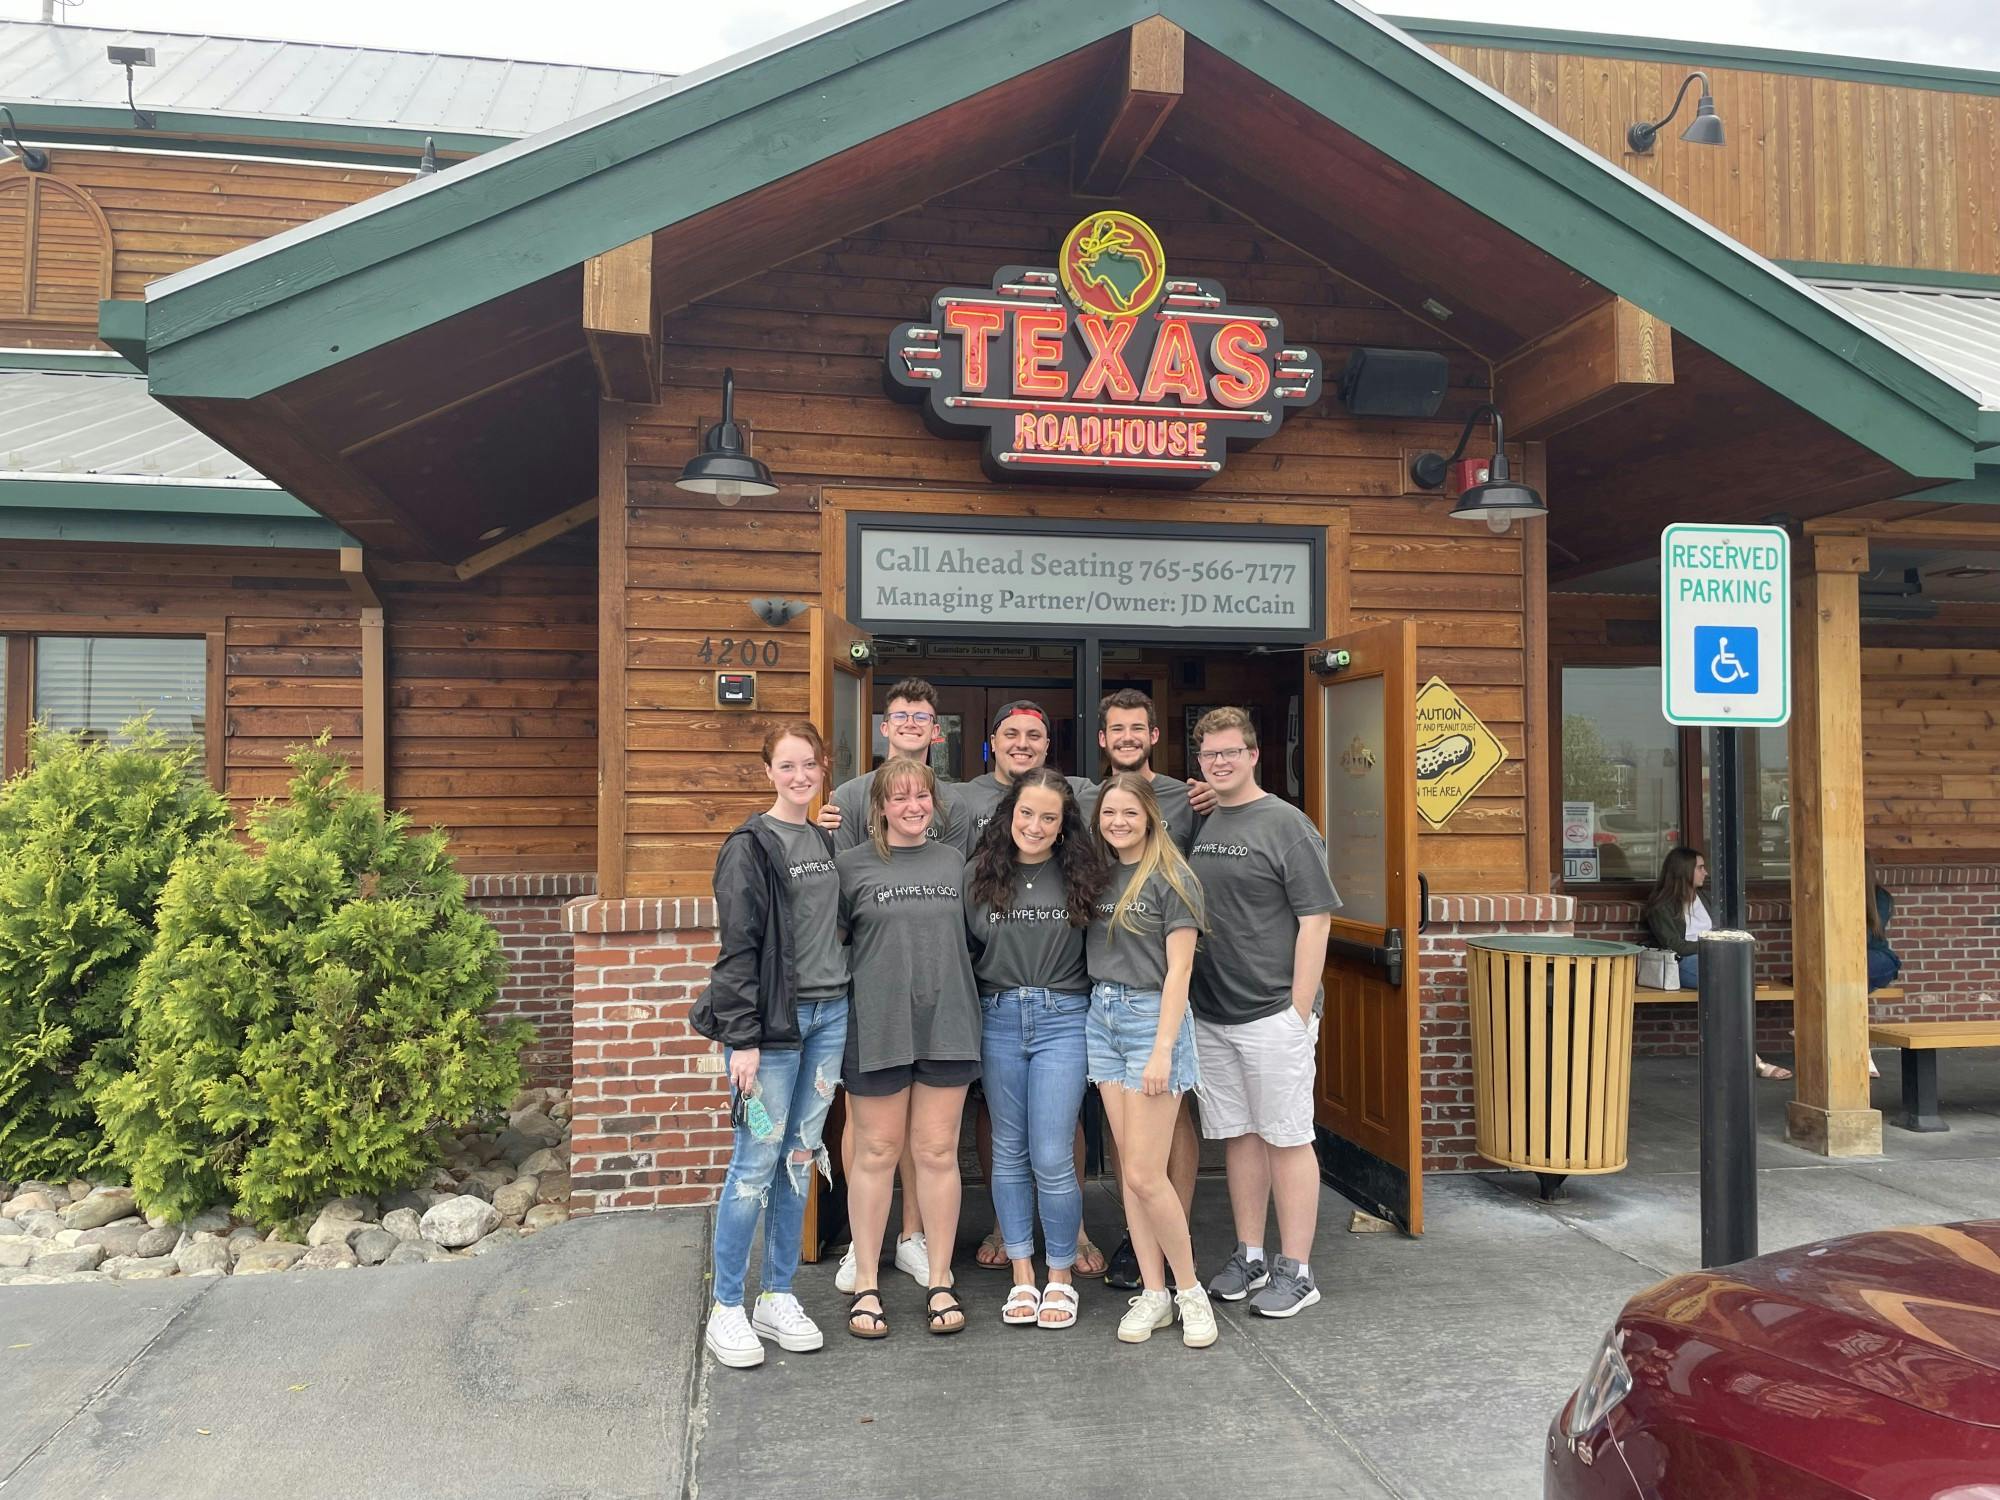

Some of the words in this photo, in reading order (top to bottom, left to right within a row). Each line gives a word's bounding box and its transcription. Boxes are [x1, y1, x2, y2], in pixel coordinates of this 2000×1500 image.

[945, 305, 1270, 409] TEXAS
[1013, 411, 1208, 457] ROADHOUSE
[875, 546, 931, 572] Call
[936, 547, 1024, 575] Ahead
[1030, 552, 1134, 585] Seating
[1139, 558, 1296, 584] 765-566-7177
[1672, 544, 1778, 571] RESERVED
[1680, 578, 1772, 604] PARKING
[876, 586, 994, 614] Managing
[998, 589, 1175, 613] Partner/Owner:
[1181, 594, 1207, 616] JD
[1213, 594, 1296, 615] McCain
[698, 637, 779, 666] 4200
[971, 646, 991, 655] Store
[1423, 723, 1436, 732] AND
[1436, 723, 1460, 732] PEANUT
[1460, 723, 1476, 732] DUST
[1422, 786, 1437, 797] THE
[1439, 785, 1462, 797] AREA
[977, 817, 991, 828] ge
[1200, 843, 1218, 853] HYPE
[1217, 843, 1228, 854] for
[1228, 845, 1248, 857] GOD
[789, 864, 804, 878] get
[802, 862, 821, 873] HYPE
[877, 889, 893, 902] get
[895, 886, 921, 896] HYPE
[922, 885, 935, 895] for
[936, 885, 957, 897] GOD
[1007, 909, 1035, 920] HYPE
[1036, 909, 1050, 920] for
[1051, 909, 1070, 920] GO
